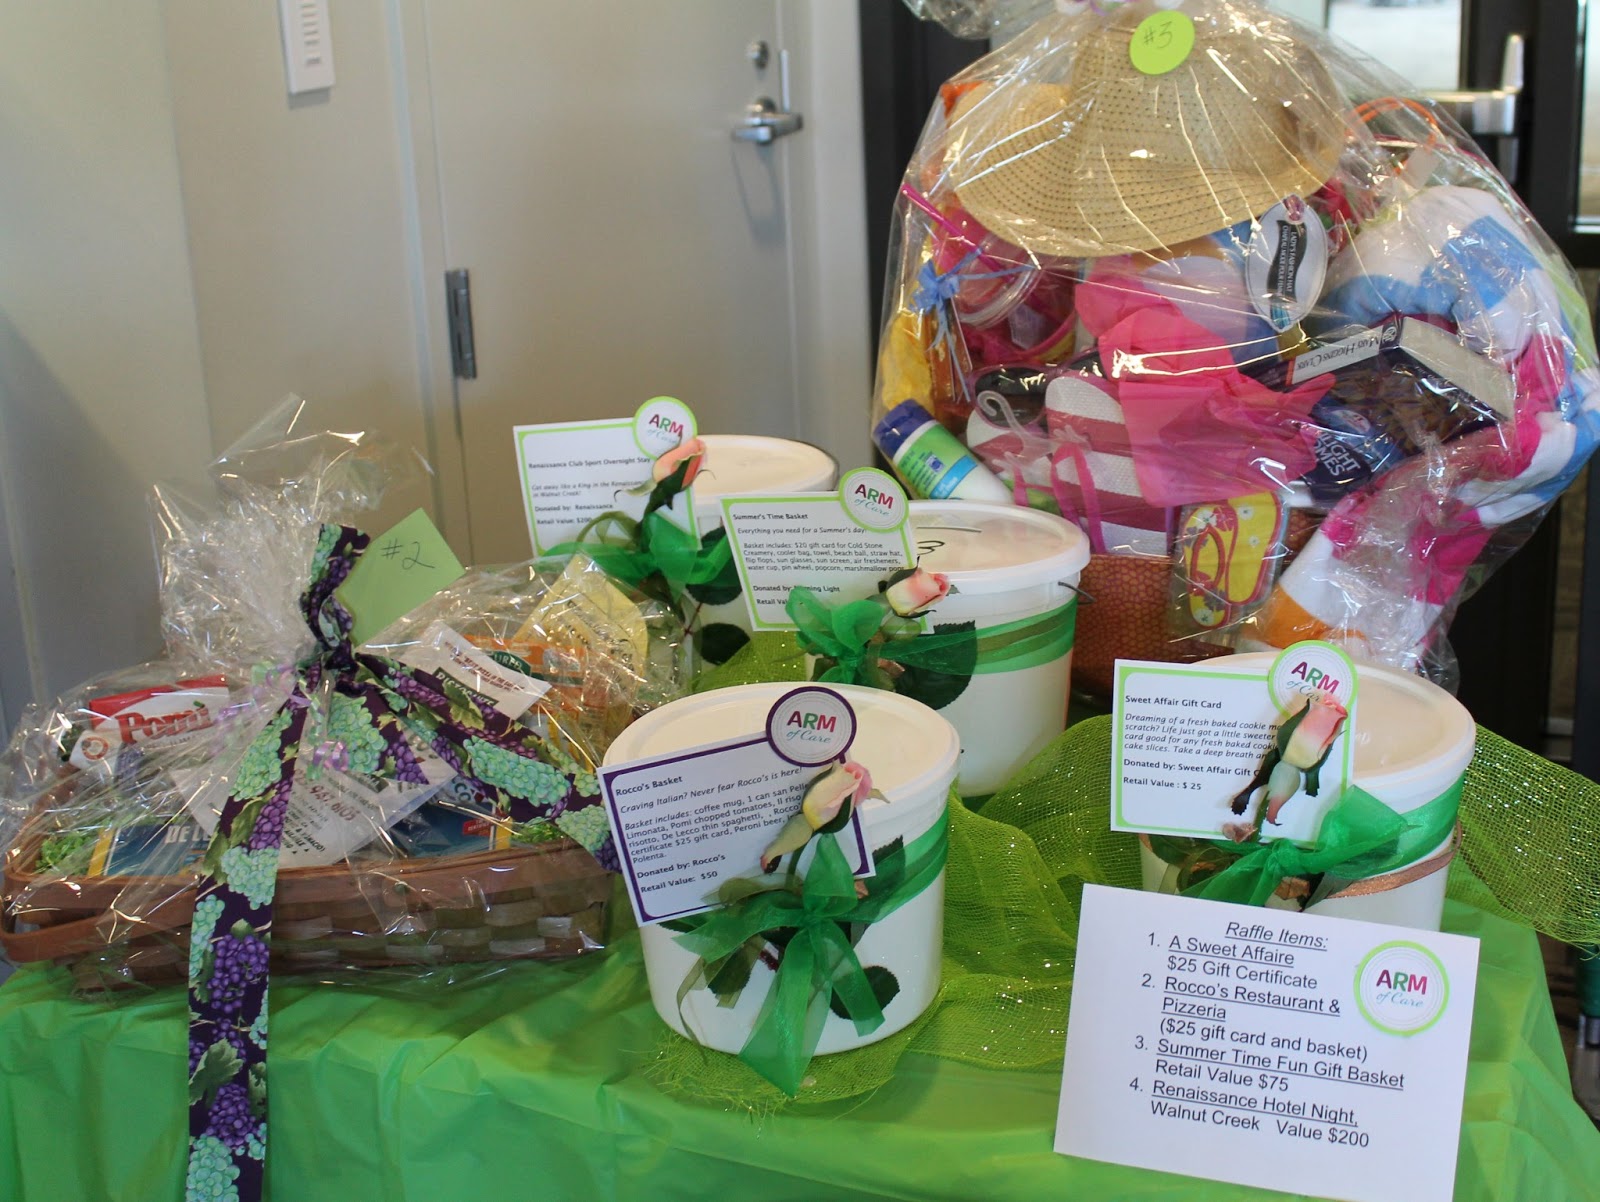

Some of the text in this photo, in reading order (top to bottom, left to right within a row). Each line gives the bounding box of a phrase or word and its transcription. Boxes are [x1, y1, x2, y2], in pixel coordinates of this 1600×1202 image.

[1143, 20, 1173, 49] #3
[1284, 230, 1298, 292] LADY'S FASHION HAT
[649, 414, 683, 437] ARM
[529, 457, 651, 469] Renaissance Club Sport Overnight Stay
[855, 484, 893, 509] ARM
[732, 513, 809, 521] Summer's Time Basket
[737, 527, 771, 535] Everything
[771, 527, 784, 535] you
[802, 527, 812, 535] for
[381, 539, 435, 570] #2
[1291, 661, 1340, 694] ARM
[1125, 695, 1221, 708] Sweet Affair Gift Card
[787, 710, 837, 733] ARM
[1124, 713, 1166, 724] Dreaming
[1168, 716, 1178, 725] of
[1186, 717, 1209, 726] fresh
[1211, 719, 1237, 727] baked
[1238, 721, 1266, 729] cookie
[1161, 725, 1176, 734] Life
[1177, 727, 1195, 735] just
[1221, 729, 1240, 738] little
[1242, 731, 1275, 740] sweeter
[800, 730, 832, 744] Care
[1123, 758, 1250, 776] Donated by: Sweet Affair Gift
[615, 776, 682, 796] Rocco's Basket
[620, 801, 653, 813] Craving
[656, 791, 687, 805] Italian?
[690, 787, 714, 797] Never
[717, 782, 735, 793] fear
[737, 774, 768, 787] Rocco's
[1123, 776, 1147, 785] Retail
[1150, 779, 1174, 787] Value
[1190, 782, 1201, 790] 25
[624, 818, 652, 830] Basket
[693, 804, 720, 814] coffee
[722, 799, 744, 808] mug,
[754, 792, 770, 800] can
[772, 788, 787, 796] san
[626, 825, 668, 839] Limonata,
[670, 818, 691, 829] Pomi
[693, 809, 730, 824] chopped
[732, 801, 775, 815] tomatoes,
[784, 794, 802, 803] riso
[628, 837, 659, 847] risotto,
[675, 827, 700, 837] Lecco
[701, 823, 719, 831] thin
[721, 812, 763, 827] spaghetti,
[630, 817, 785, 856] certificate $25 gift card, Peroni beer,
[632, 852, 666, 864] Polenta.
[636, 864, 674, 878] Donated
[692, 854, 725, 866] Rocco's
[640, 870, 717, 893] Retail Value: $50
[1225, 921, 1328, 950] Raffle Items:
[1148, 932, 1294, 967] 1. A Sweet Affaire
[1167, 955, 1317, 989] $25 Gift Certificate
[1376, 969, 1428, 995] ARM
[1141, 973, 1340, 1013] 2. Rocco's Restaurant &
[1375, 991, 1424, 1008] of Care
[1162, 996, 1226, 1019] Pizzeria
[1160, 1017, 1367, 1063] ($25 gift card and basket)
[1134, 1034, 1404, 1087] 3. Summer Time Fun Gift Basket
[1155, 1059, 1288, 1091] Retail Value $75
[1129, 1077, 1358, 1127] 4. Renaissance Hotel Night,
[1151, 1100, 1369, 1147] Walnut Creek Value $200
